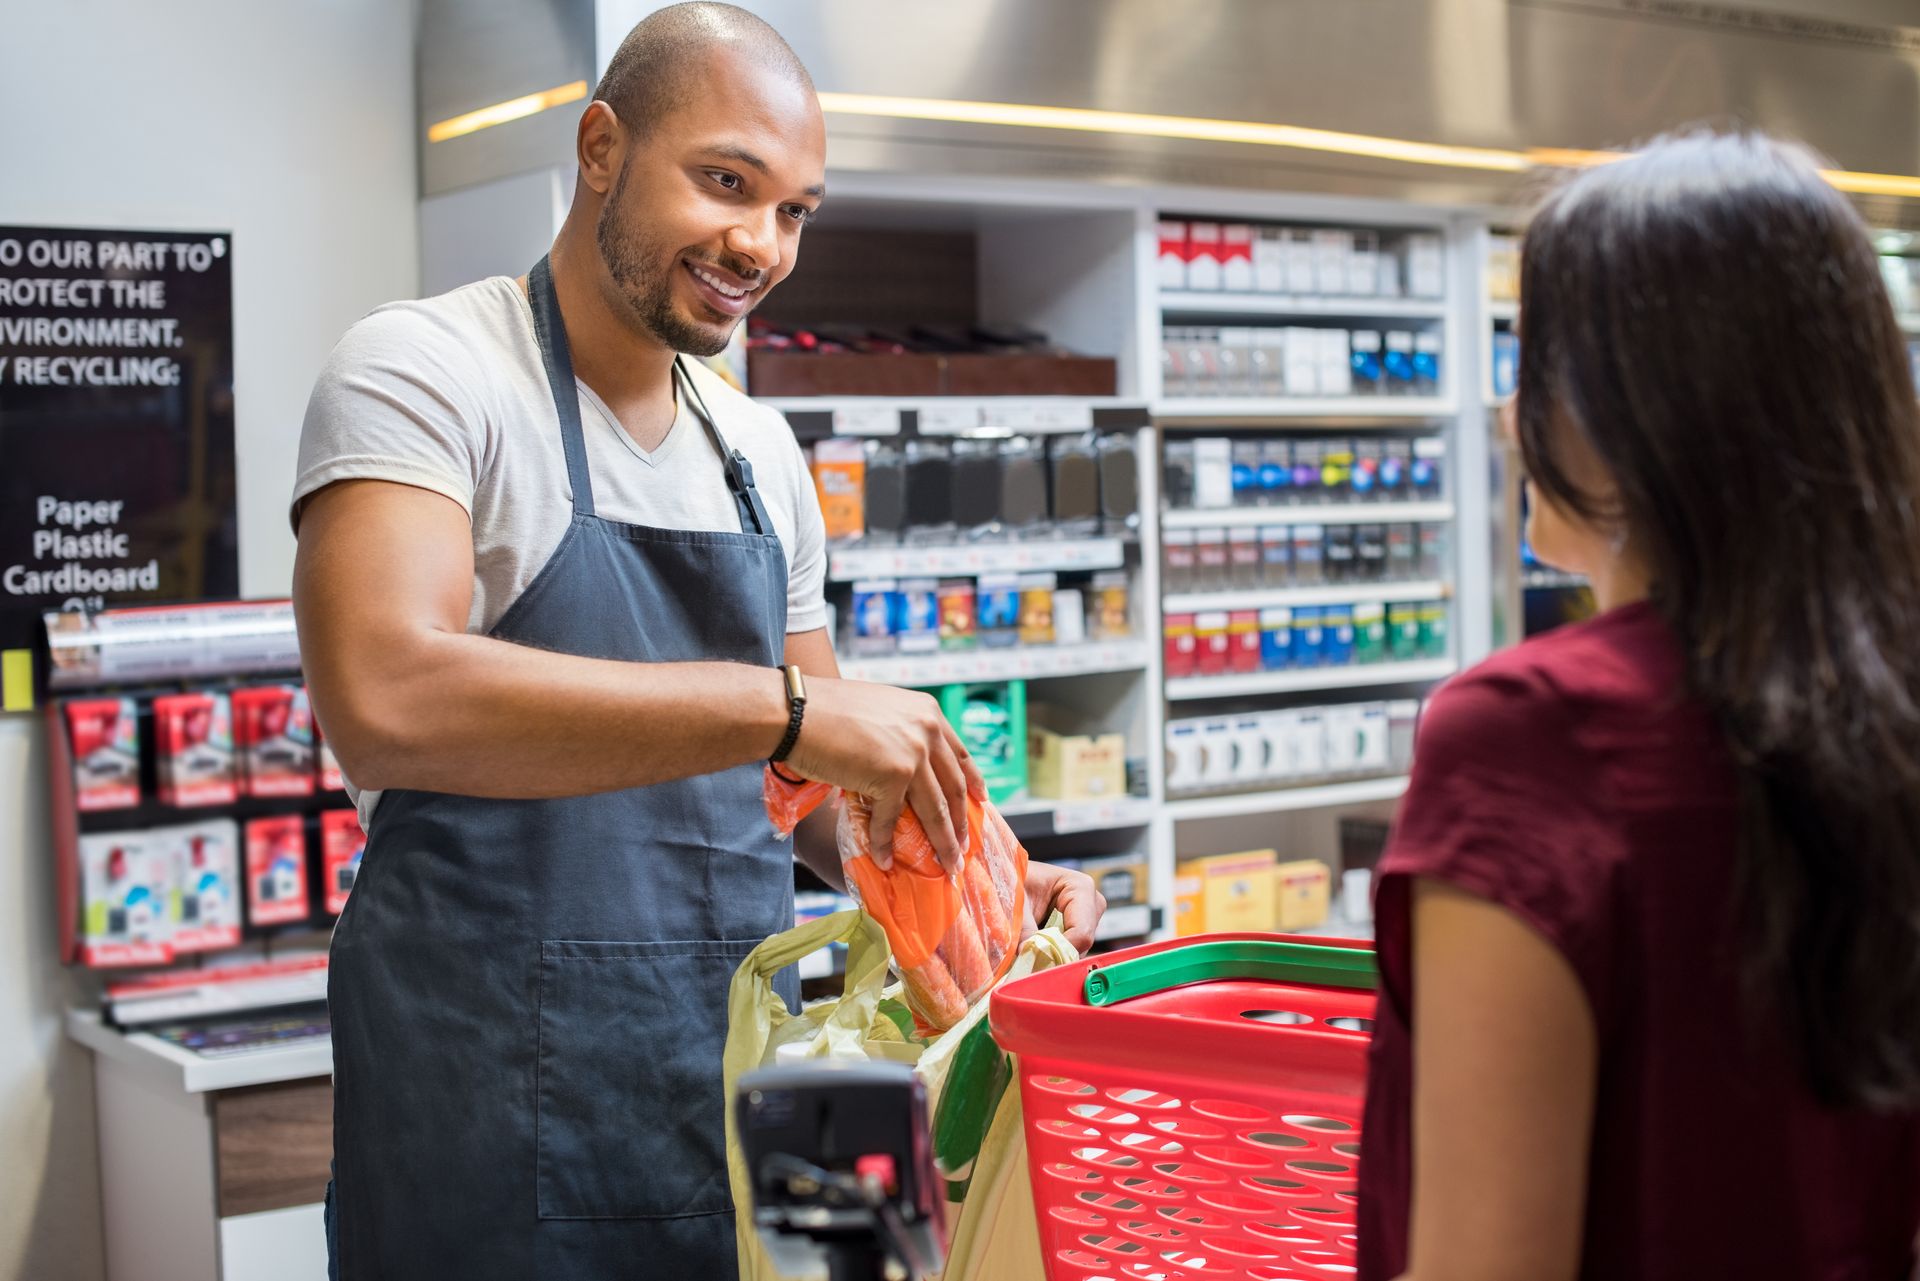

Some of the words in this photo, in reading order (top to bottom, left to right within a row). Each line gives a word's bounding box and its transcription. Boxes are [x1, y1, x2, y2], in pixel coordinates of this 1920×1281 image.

[27, 239, 92, 269] OUR
[97, 241, 170, 271] PART
[171, 243, 212, 272] TO
[0, 278, 105, 308] ROTECT
[108, 280, 166, 309] THE
[0, 317, 183, 348] VIRONMENT.
[14, 356, 180, 386] RECYCLING:
[37, 496, 122, 531] Paper
[34, 529, 128, 559] Plastic
[3, 560, 158, 594] Cardboard
